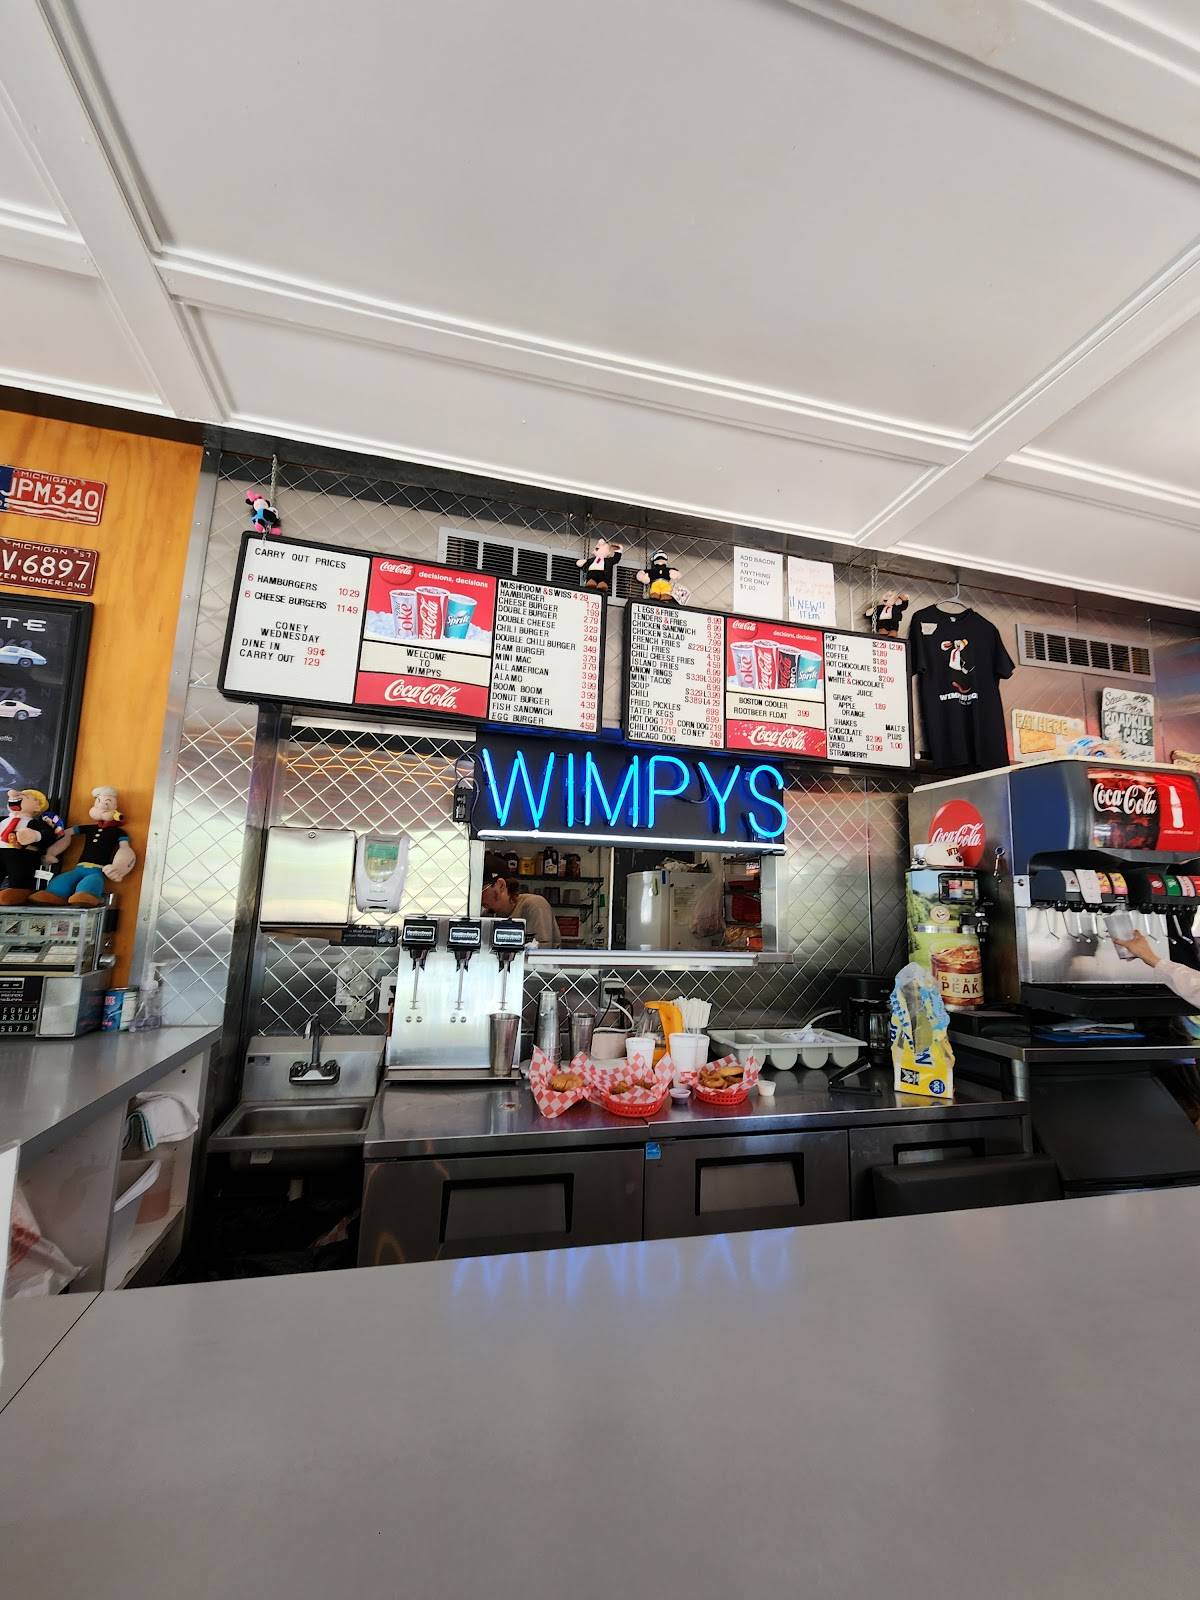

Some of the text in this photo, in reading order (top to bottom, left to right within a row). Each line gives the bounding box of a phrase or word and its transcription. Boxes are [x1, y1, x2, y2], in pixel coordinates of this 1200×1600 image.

[21, 470, 77, 485] MICHIGAN
[0, 477, 99, 510] JPM340
[12, 542, 68, 554] MICHIGAN
[255, 548, 346, 569] CARRY OUT PRICES
[754, 557, 775, 565] BACON
[379, 561, 413, 575] Coca-Cola
[740, 570, 770, 579] ANYTHING
[21, 575, 86, 589] WONDERLAND
[257, 575, 317, 591] HAMBURGERS
[418, 571, 488, 588] decisions, decisions
[500, 581, 541, 594] MUSHROOM
[245, 590, 250, 598] 6
[255, 592, 285, 603] CHEESE
[289, 597, 327, 609] BURGERS
[500, 589, 544, 602] HAMBURGER
[499, 597, 558, 612] CHEESE BURGER
[498, 605, 557, 619] DOUBLE BURGER
[638, 606, 679, 618] LEGS FRIES
[448, 615, 469, 626] Sprite
[498, 615, 555, 628] DOUBLE CHEESE
[633, 613, 687, 626] TENDERS FRIES
[276, 621, 308, 632] CONEY
[497, 624, 549, 637] CHILI BURGER
[633, 620, 696, 635] CHICKEN SANDWICH
[261, 628, 319, 643] WEDNESDAY
[633, 627, 685, 640] CHICKEN SALAD
[242, 638, 264, 648] DINE
[270, 642, 280, 650] IN
[496, 634, 575, 650] DOUBLE CHILI BURGER
[632, 643, 648, 651] CHILI
[633, 635, 680, 648] FRENCH FRIES
[240, 649, 273, 660] CARRY
[278, 654, 295, 663] OUT
[407, 649, 447, 661] WELCOME
[516, 646, 544, 655] BURGER
[826, 651, 848, 660] COFFEE
[495, 653, 531, 663] MINI MAC
[632, 650, 694, 665] CHILI CHEESE FRIES
[632, 658, 678, 670] ISLAND FRIES
[407, 666, 441, 677] WIMPYS
[495, 663, 549, 676] ALL AMERICAN
[630, 666, 672, 677] ONION RINGS
[838, 661, 870, 671] CHOCOLATE
[494, 673, 522, 682] ALAMO
[650, 676, 671, 684] TACOS
[828, 676, 884, 688] WHITE CHOCOLATE
[494, 682, 542, 694] BOOM BOOM
[631, 681, 649, 689] SOUP
[385, 679, 461, 708] Coca-Cola
[492, 692, 549, 705] DONUT BURGER
[631, 689, 648, 697] CHILI
[493, 702, 552, 716] FISH SANDWICH
[631, 699, 680, 711] FRIED PICKLES
[739, 697, 788, 709] BOSTON COOLER
[492, 712, 544, 724] EGG BURGER
[631, 706, 673, 718] TATER KEGS
[734, 707, 767, 717] ROOTBEER
[769, 710, 787, 719] FLOAT
[842, 709, 865, 718] ORANGE
[645, 716, 658, 724] DOG
[677, 720, 694, 728] CORN
[697, 722, 708, 730] DOG
[834, 718, 905, 732] SHAKES MALTS
[1104, 711, 1153, 730] ROADKILL
[629, 730, 675, 742] CHICAGO DOG
[630, 722, 648, 731] CHILI
[650, 724, 663, 732] DOG
[682, 729, 705, 737] CONEY
[829, 727, 862, 736] CHOCOLATE
[1124, 728, 1150, 744] CAFE
[748, 725, 807, 751] Coca-Cola
[829, 734, 853, 742] VANILLA
[482, 748, 788, 838] WIMPYS
[1093, 783, 1157, 815] Coca-Cola
[942, 982, 980, 994] PEAK
